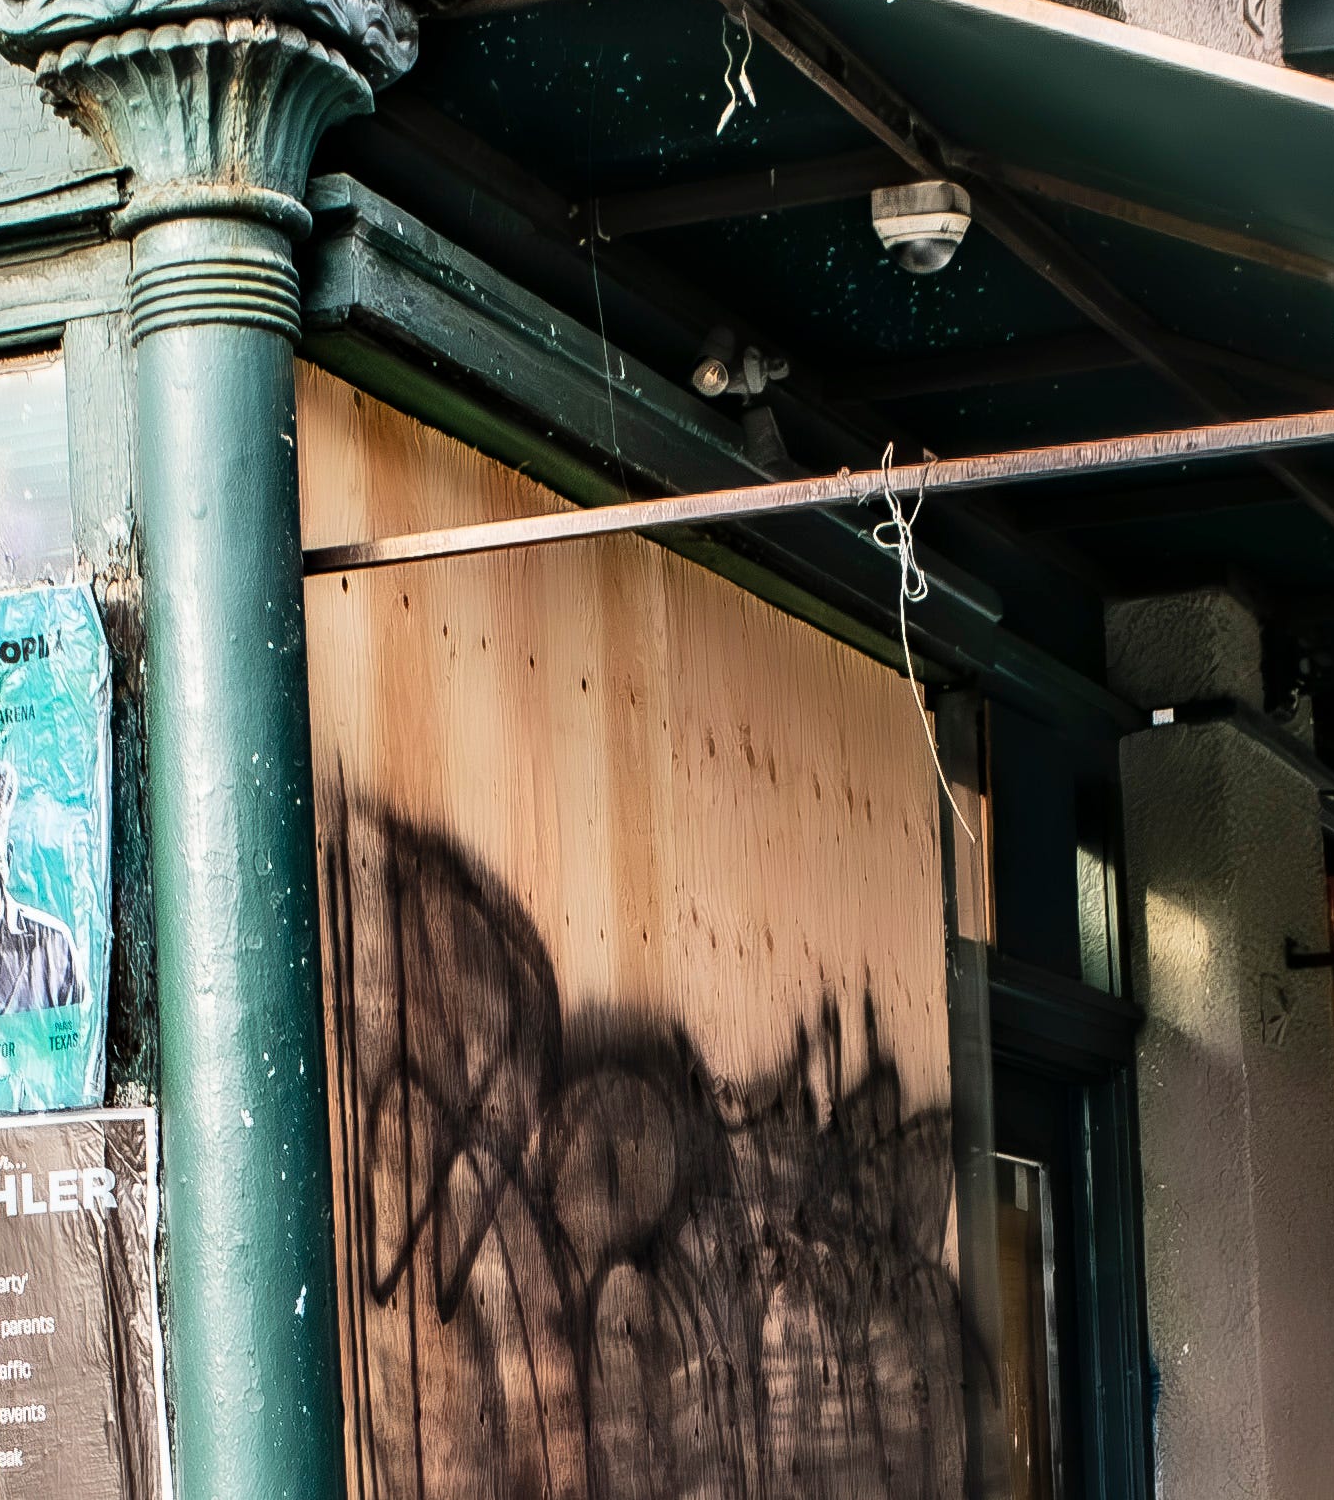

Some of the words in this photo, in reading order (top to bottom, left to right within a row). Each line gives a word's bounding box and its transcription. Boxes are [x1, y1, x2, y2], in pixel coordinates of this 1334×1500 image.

[49, 1033, 79, 1050] TEXAS
[1, 1315, 55, 1339] parents
[0, 1404, 47, 1423] events
